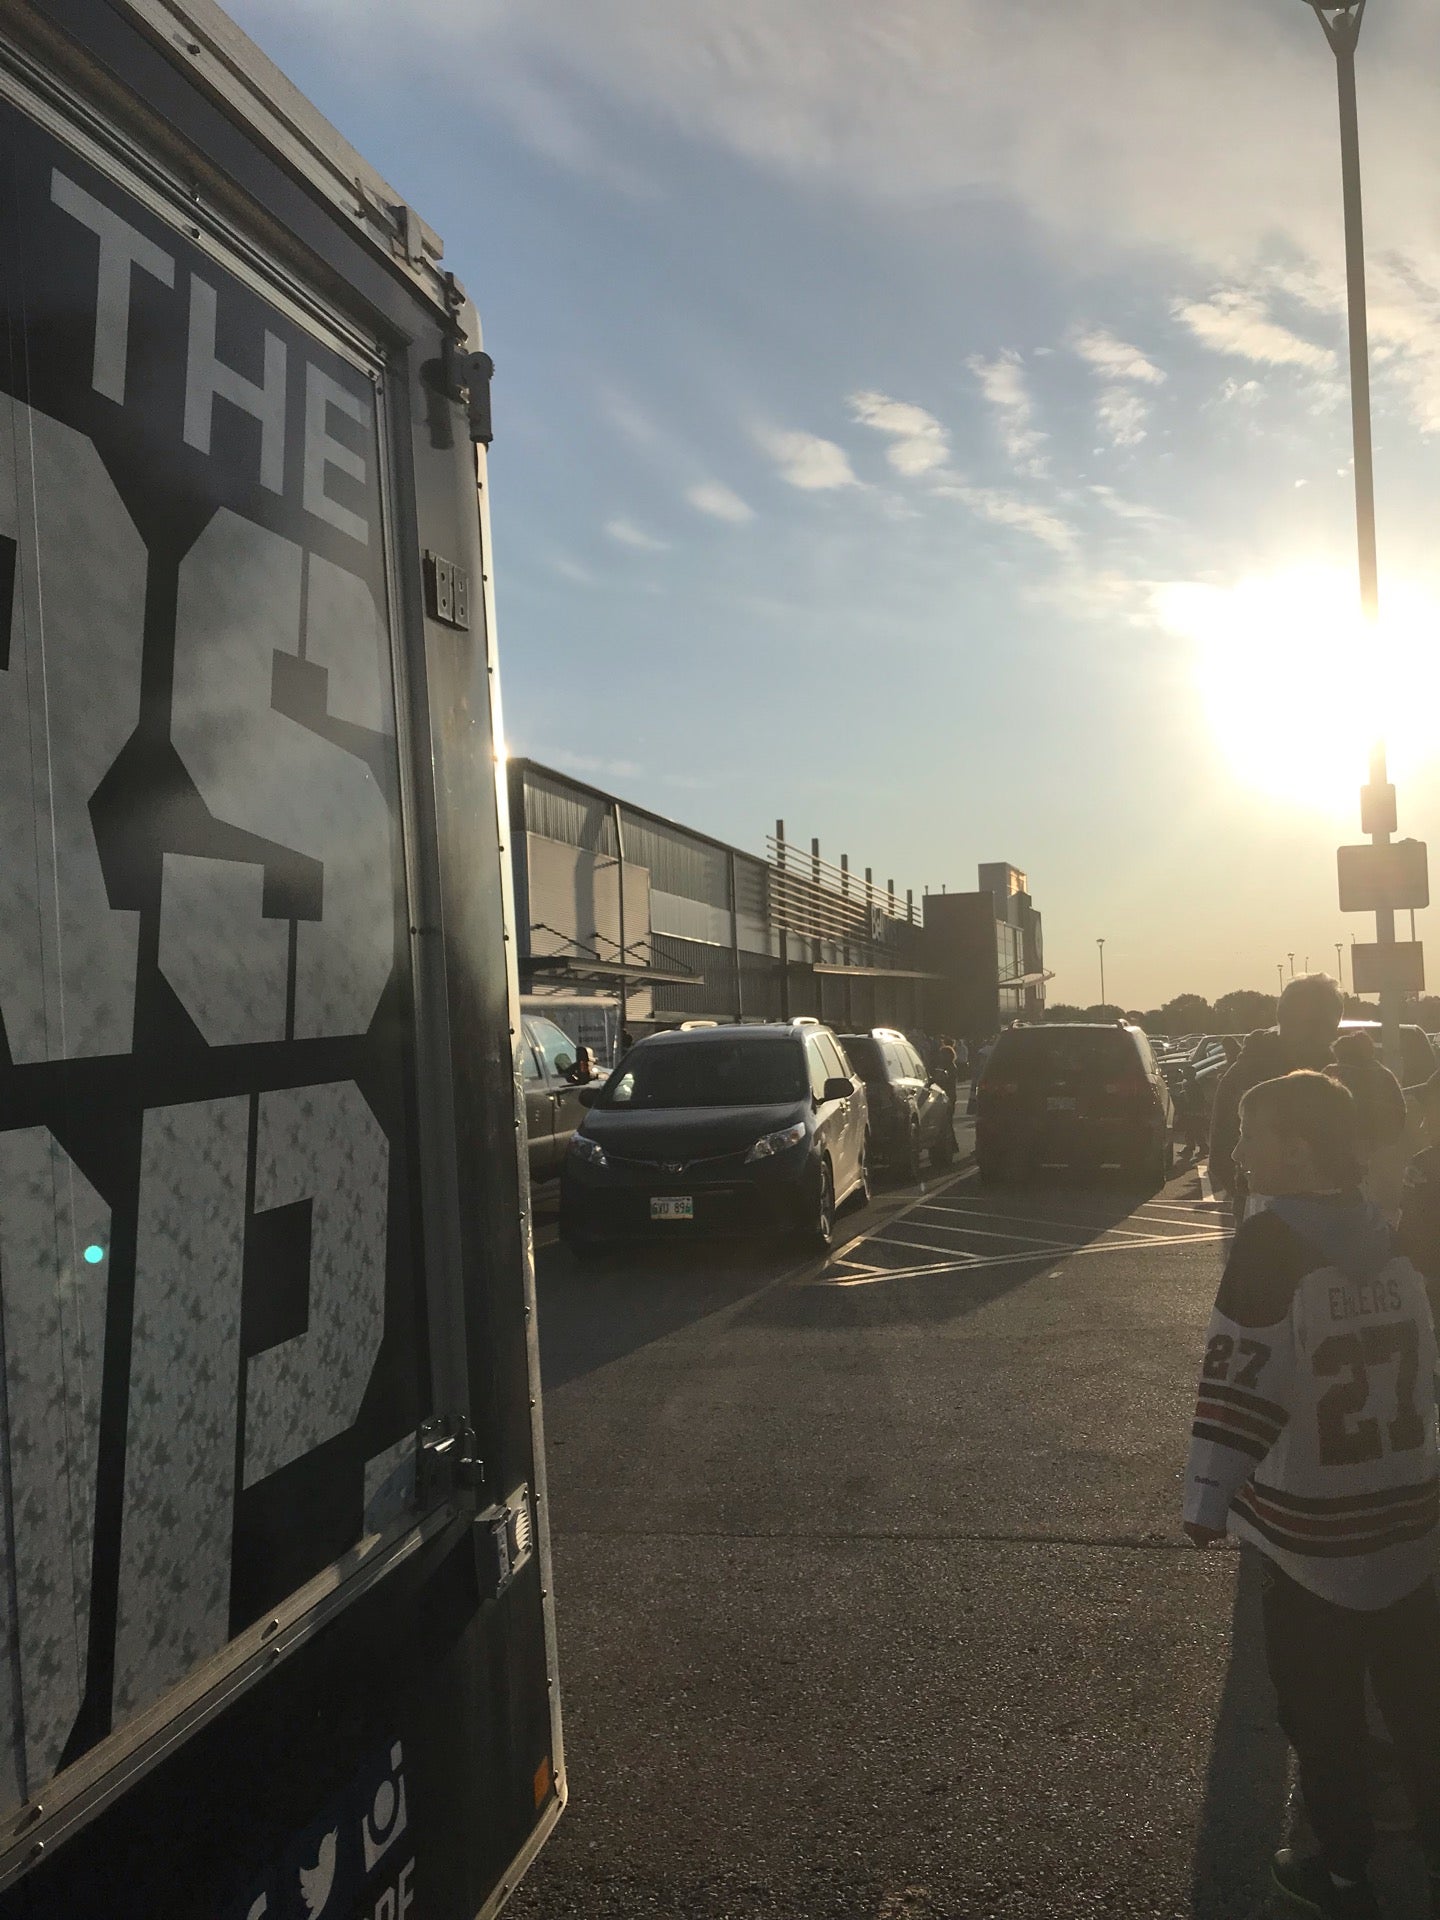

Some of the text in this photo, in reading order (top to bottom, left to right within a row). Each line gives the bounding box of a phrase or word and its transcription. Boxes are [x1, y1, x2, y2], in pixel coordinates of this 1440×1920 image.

[50, 168, 371, 545] THE
[1203, 1334, 1272, 1389] 27
[1311, 1318, 1425, 1467] 27
